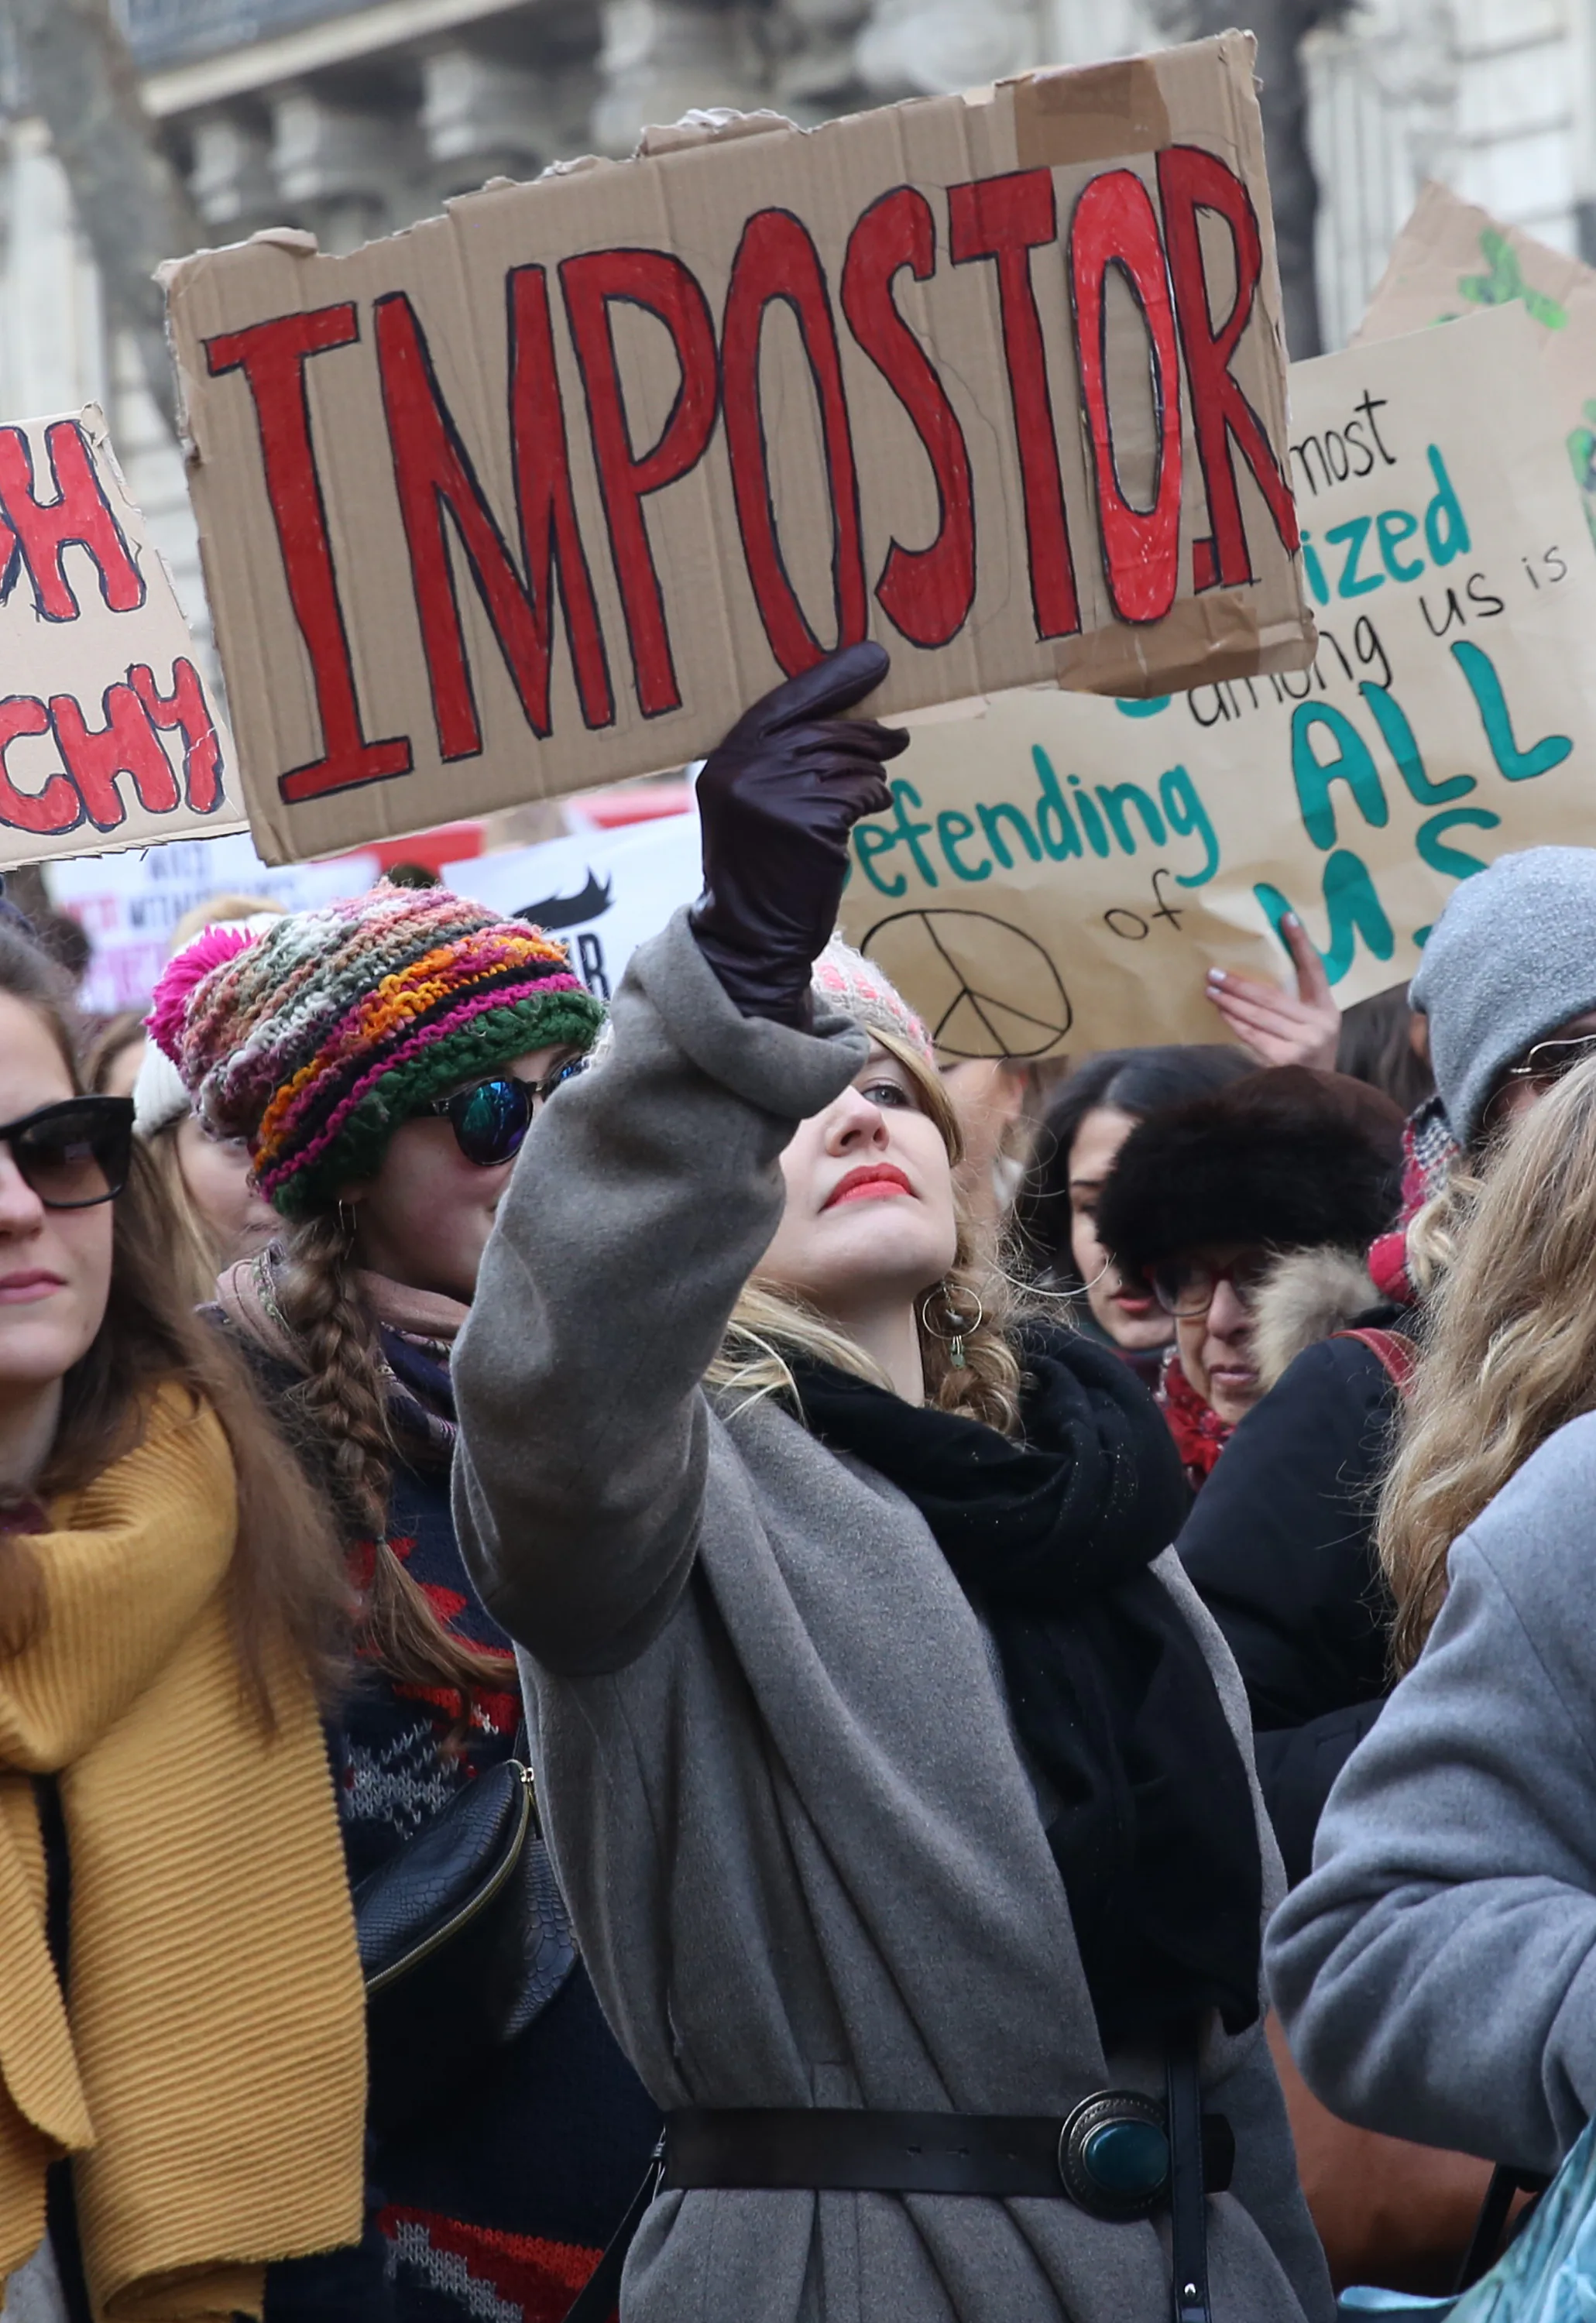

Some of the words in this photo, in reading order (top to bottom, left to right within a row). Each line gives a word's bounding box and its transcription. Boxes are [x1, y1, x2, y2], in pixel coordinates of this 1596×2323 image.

[204, 144, 1301, 803] IMPOSTOR
[1419, 573, 1505, 637] us
[1522, 547, 1567, 589] is
[1290, 640, 1574, 851] ALL
[1103, 868, 1185, 940] of
